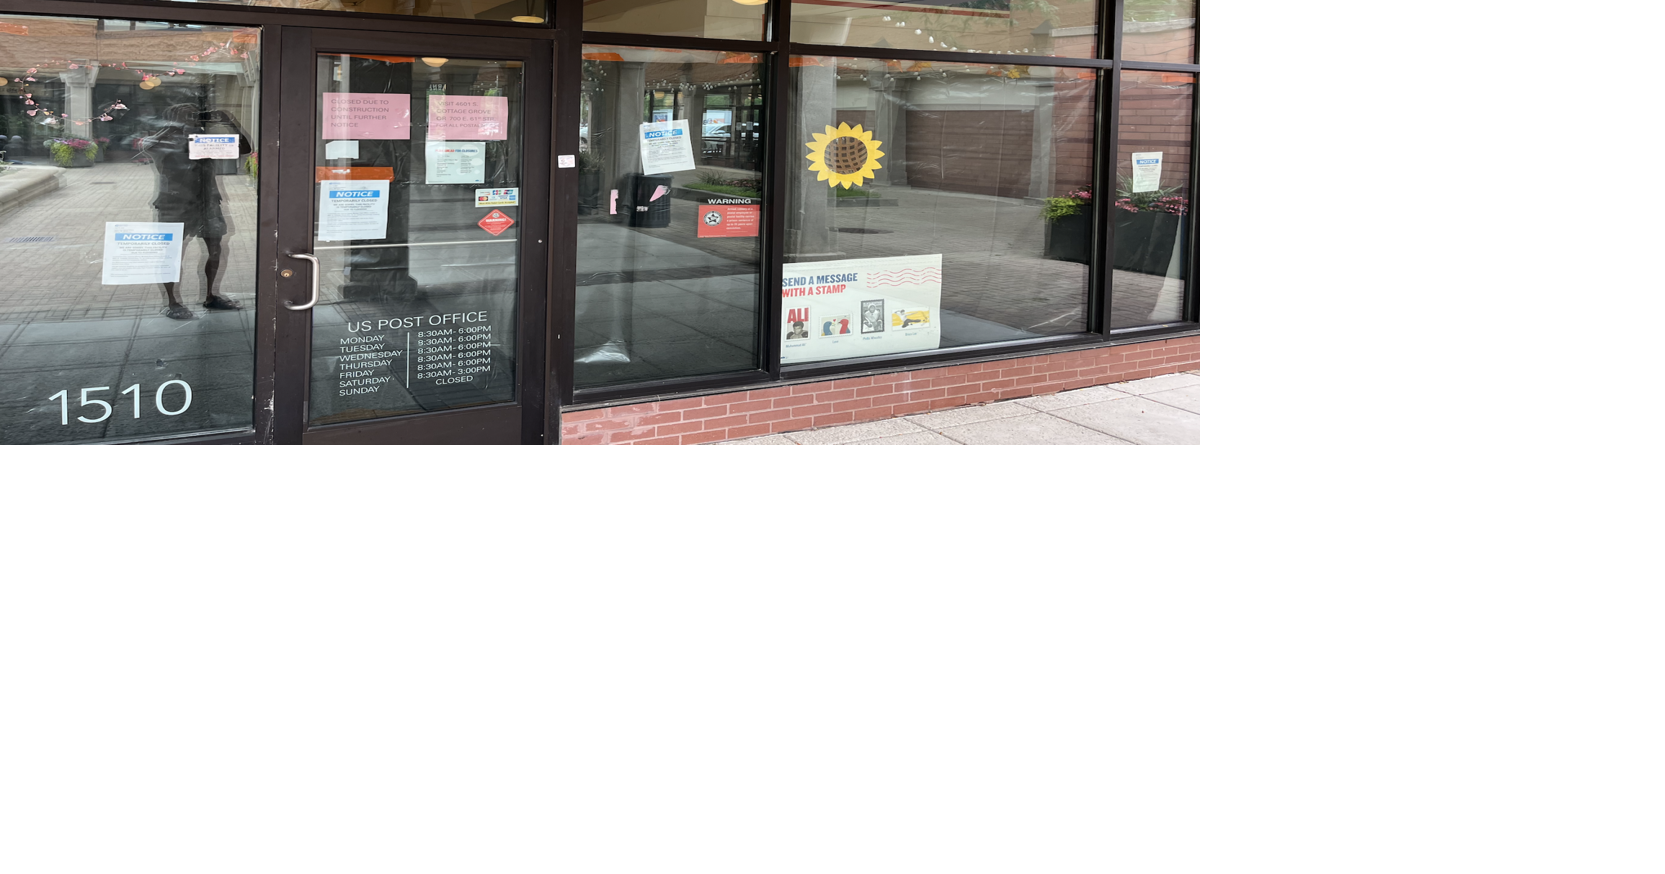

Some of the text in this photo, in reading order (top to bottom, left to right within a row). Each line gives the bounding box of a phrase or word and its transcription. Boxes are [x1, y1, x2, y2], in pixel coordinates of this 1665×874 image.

[782, 273, 858, 287] SEND A MESSAGE
[782, 284, 846, 298] WITH A STAMP
[787, 307, 809, 323] ALI
[348, 311, 487, 332] US POST OFFICE
[458, 325, 491, 334] 6:00PM
[340, 335, 385, 345] MONDAY
[458, 333, 491, 342] 6:00PM
[340, 343, 385, 353] TUESDAY
[458, 341, 491, 350] 6:00PM
[340, 350, 403, 362] WEDNESDAY
[458, 350, 491, 358] 6:00PM
[340, 359, 392, 370] THURSDAY
[458, 357, 491, 366] 6:00PM
[340, 369, 374, 379] FRIDAY
[458, 365, 491, 375] 3:00PM
[339, 376, 391, 387] SATURDAY
[436, 376, 473, 385] CLOSED
[339, 386, 380, 397] SUNDAY
[49, 379, 192, 425] 1510
